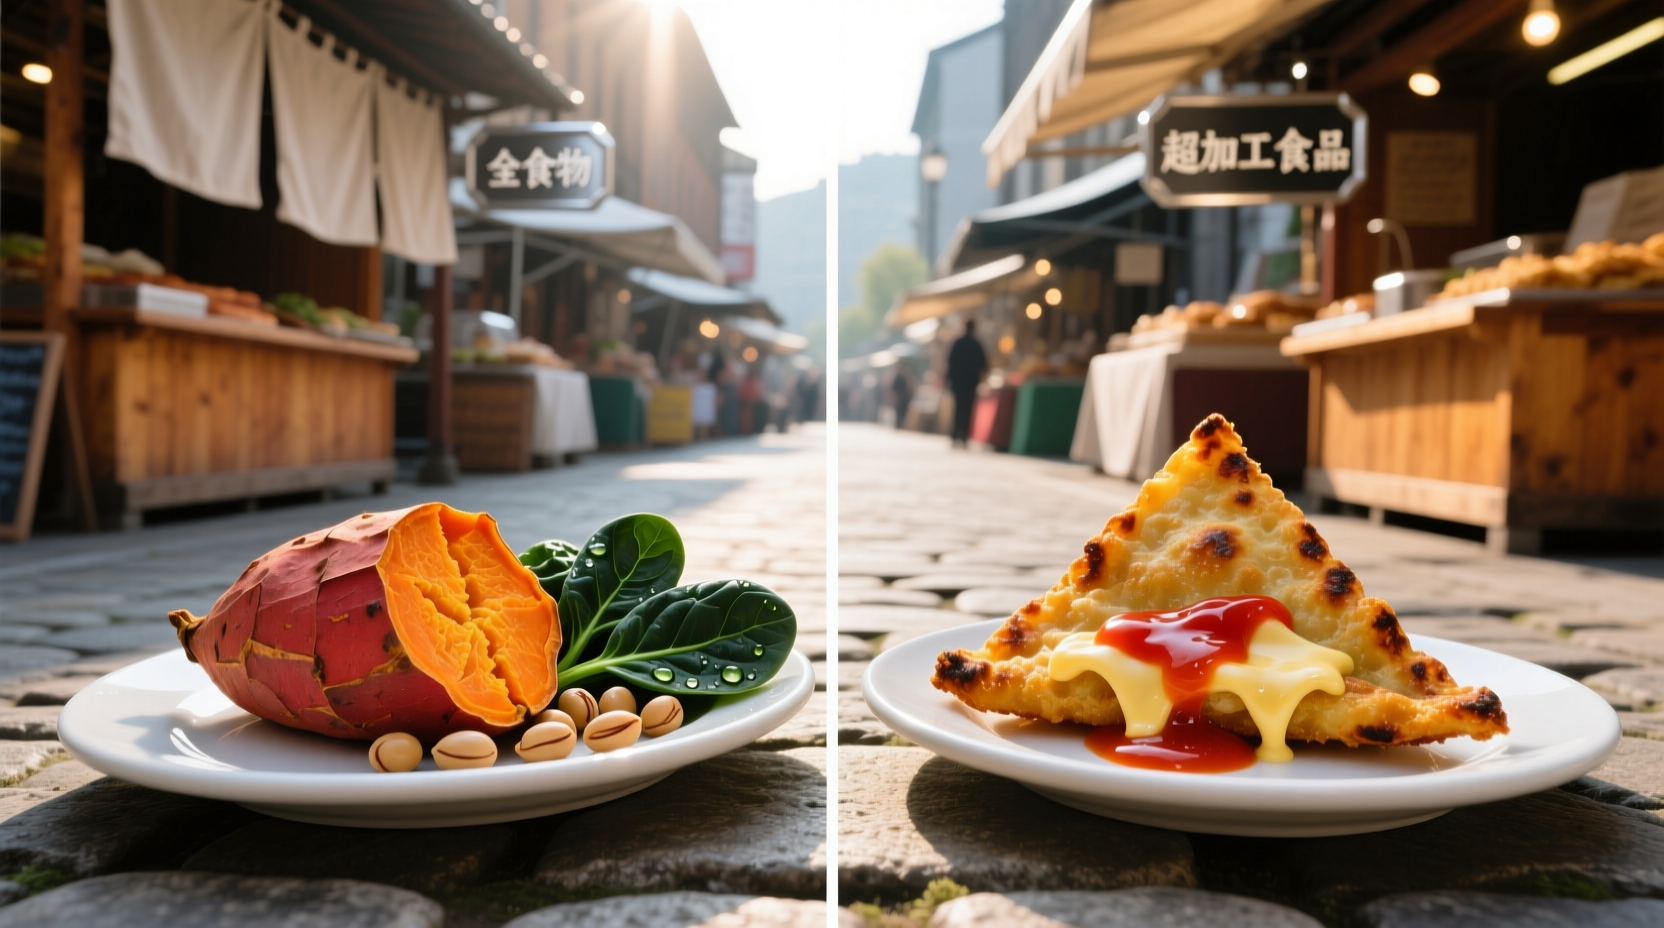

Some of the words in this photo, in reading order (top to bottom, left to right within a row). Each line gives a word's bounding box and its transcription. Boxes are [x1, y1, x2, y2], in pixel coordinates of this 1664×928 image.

[486, 146, 592, 190] 全食物
[1160, 126, 1350, 175] 超加工食品
